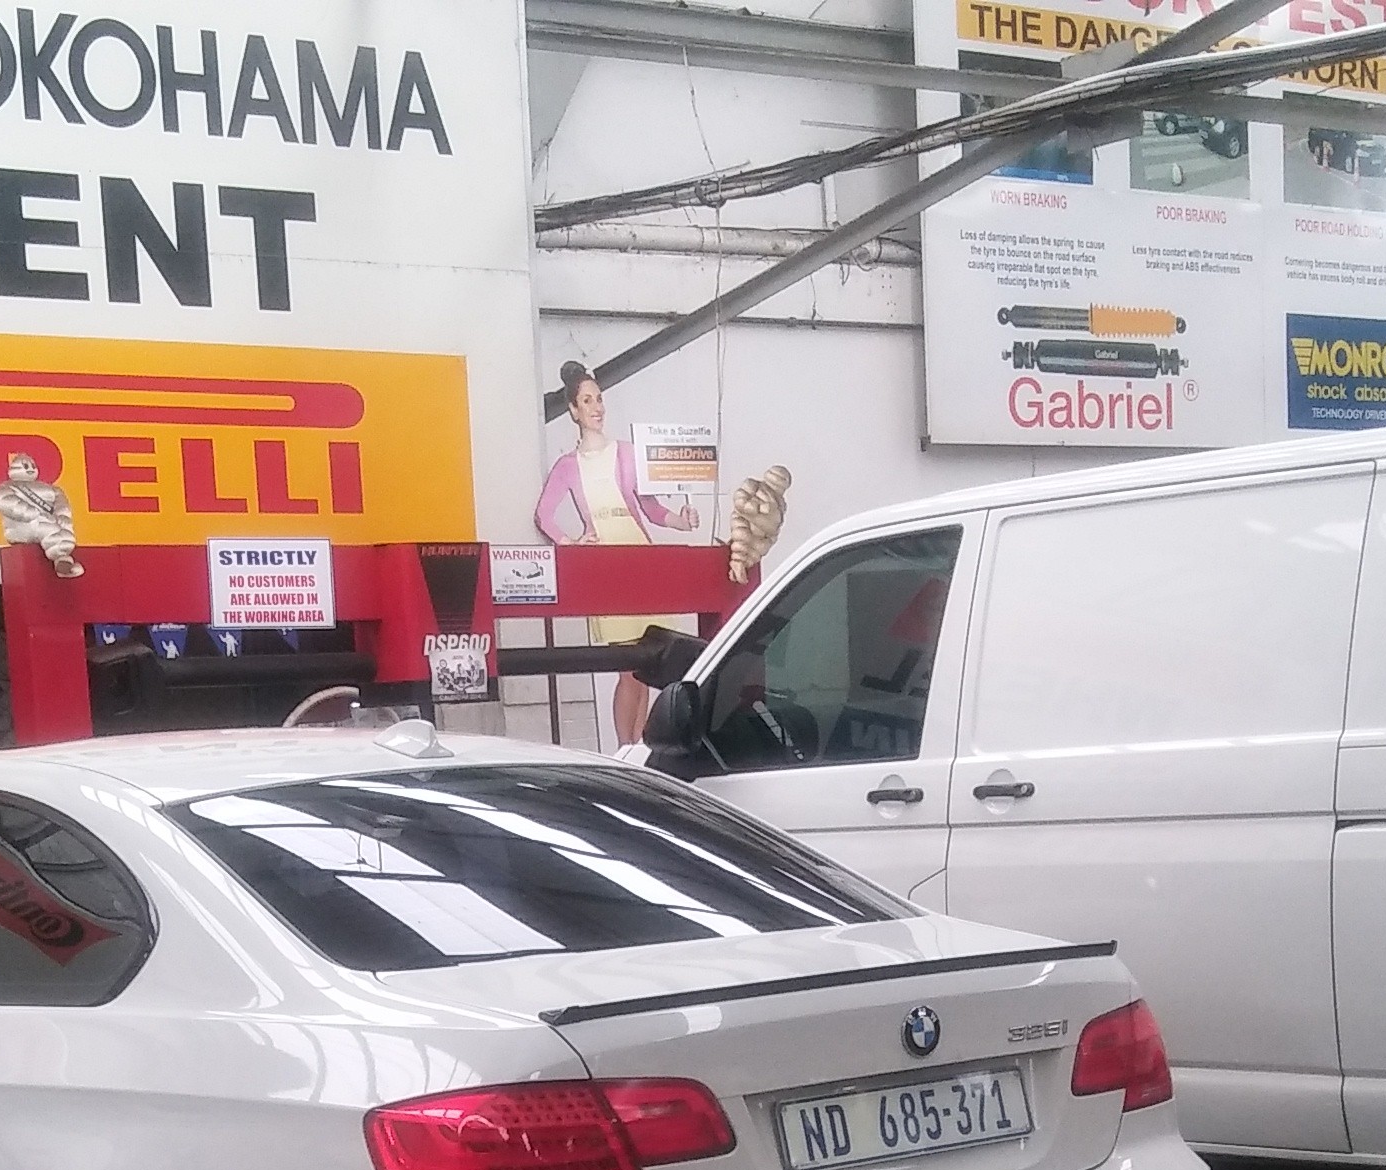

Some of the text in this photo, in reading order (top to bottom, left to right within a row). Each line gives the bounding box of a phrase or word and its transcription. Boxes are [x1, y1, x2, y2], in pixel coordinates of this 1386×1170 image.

[970, 4, 1043, 45] THE
[1024, 191, 1067, 209] BRAKING
[1157, 206, 1226, 224] POOR BRAKING
[960, 229, 976, 240] Loss
[979, 231, 985, 239] of
[1041, 236, 1051, 246] the
[1078, 240, 1084, 248] to
[971, 245, 981, 255] the
[998, 248, 1005, 257] to
[1043, 250, 1053, 260] the
[1307, 382, 1347, 399] shock
[1008, 377, 1173, 430] Gabriel
[1312, 407, 1363, 420] TECHNOLOGY
[219, 550, 317, 566] STRICTLY
[493, 550, 551, 559] WARNING
[229, 575, 315, 587] NO CUSTOMERS
[230, 593, 318, 605] ARE ALLOWED IN
[223, 610, 324, 624] THE WORKING AREA
[424, 634, 491, 656] DSP600
[800, 1079, 1012, 1161] ND 685-371
